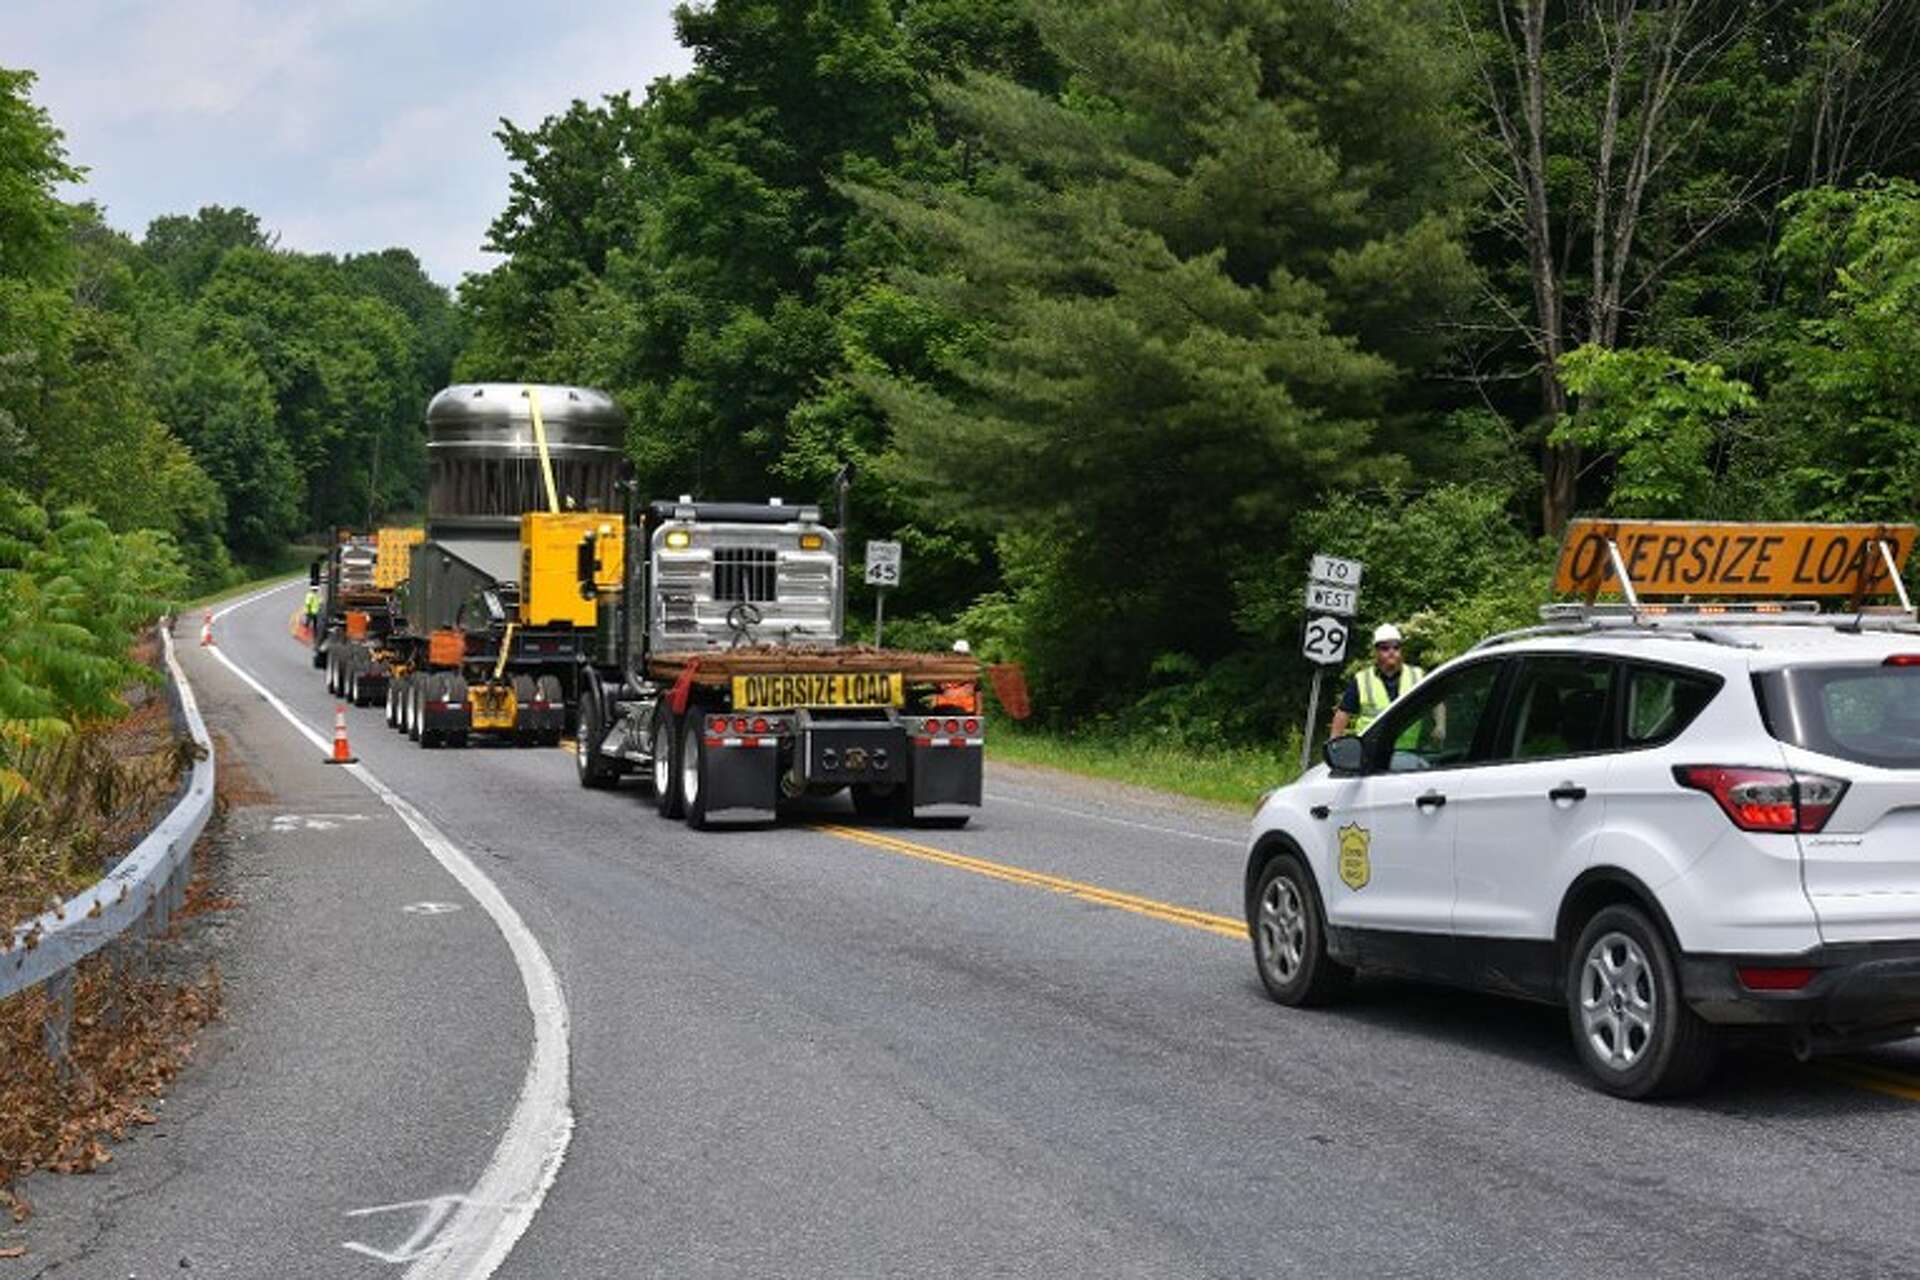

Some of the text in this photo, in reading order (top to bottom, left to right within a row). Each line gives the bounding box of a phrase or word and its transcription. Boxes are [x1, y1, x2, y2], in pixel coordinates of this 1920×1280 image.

[869, 563, 896, 580] 45
[1325, 561, 1348, 579] TO
[1792, 536, 1900, 583] LOAD
[1305, 625, 1344, 655] 29
[745, 674, 891, 706] OVERSIZE LOAD
